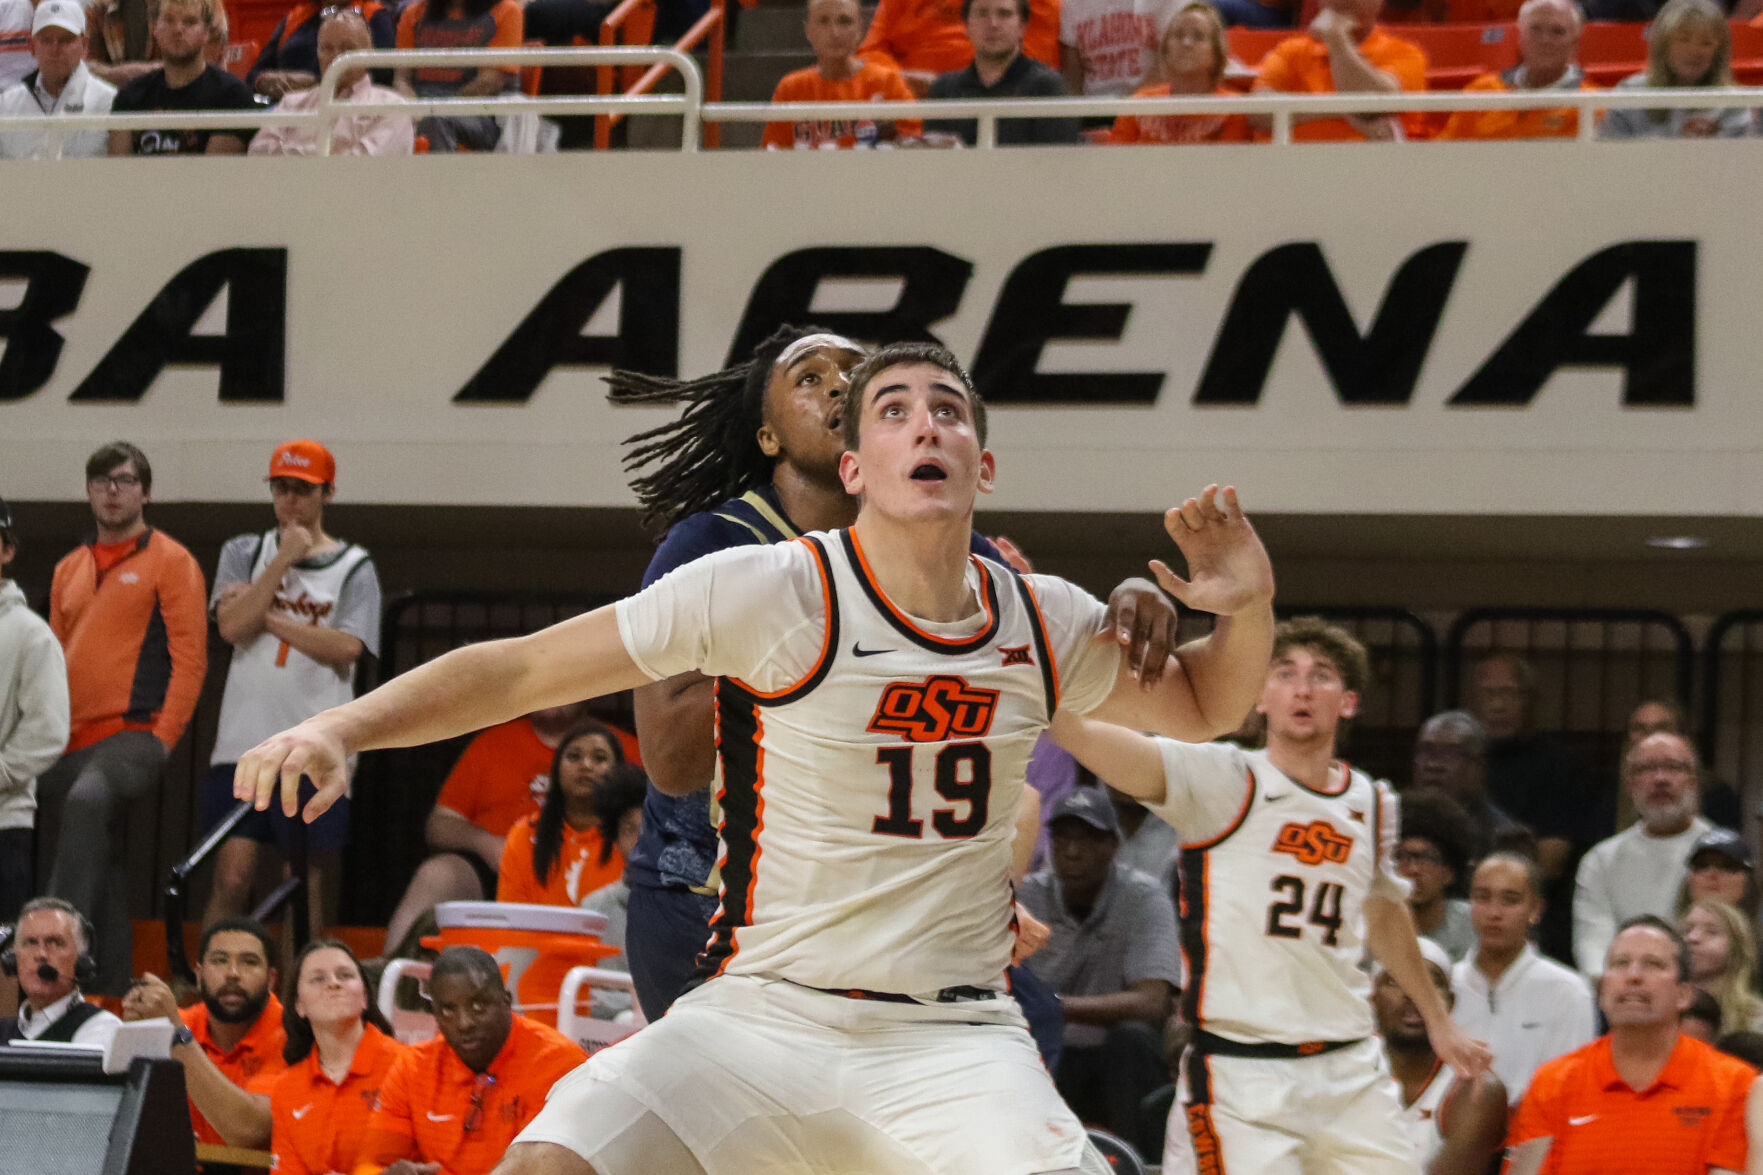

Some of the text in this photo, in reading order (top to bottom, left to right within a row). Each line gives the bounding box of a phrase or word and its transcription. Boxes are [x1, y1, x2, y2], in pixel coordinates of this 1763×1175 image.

[452, 240, 1698, 408] ARENA
[866, 674, 1000, 743] OSU
[871, 740, 992, 840] 19
[1270, 819, 1355, 866] OSU
[1265, 874, 1346, 947] 24
